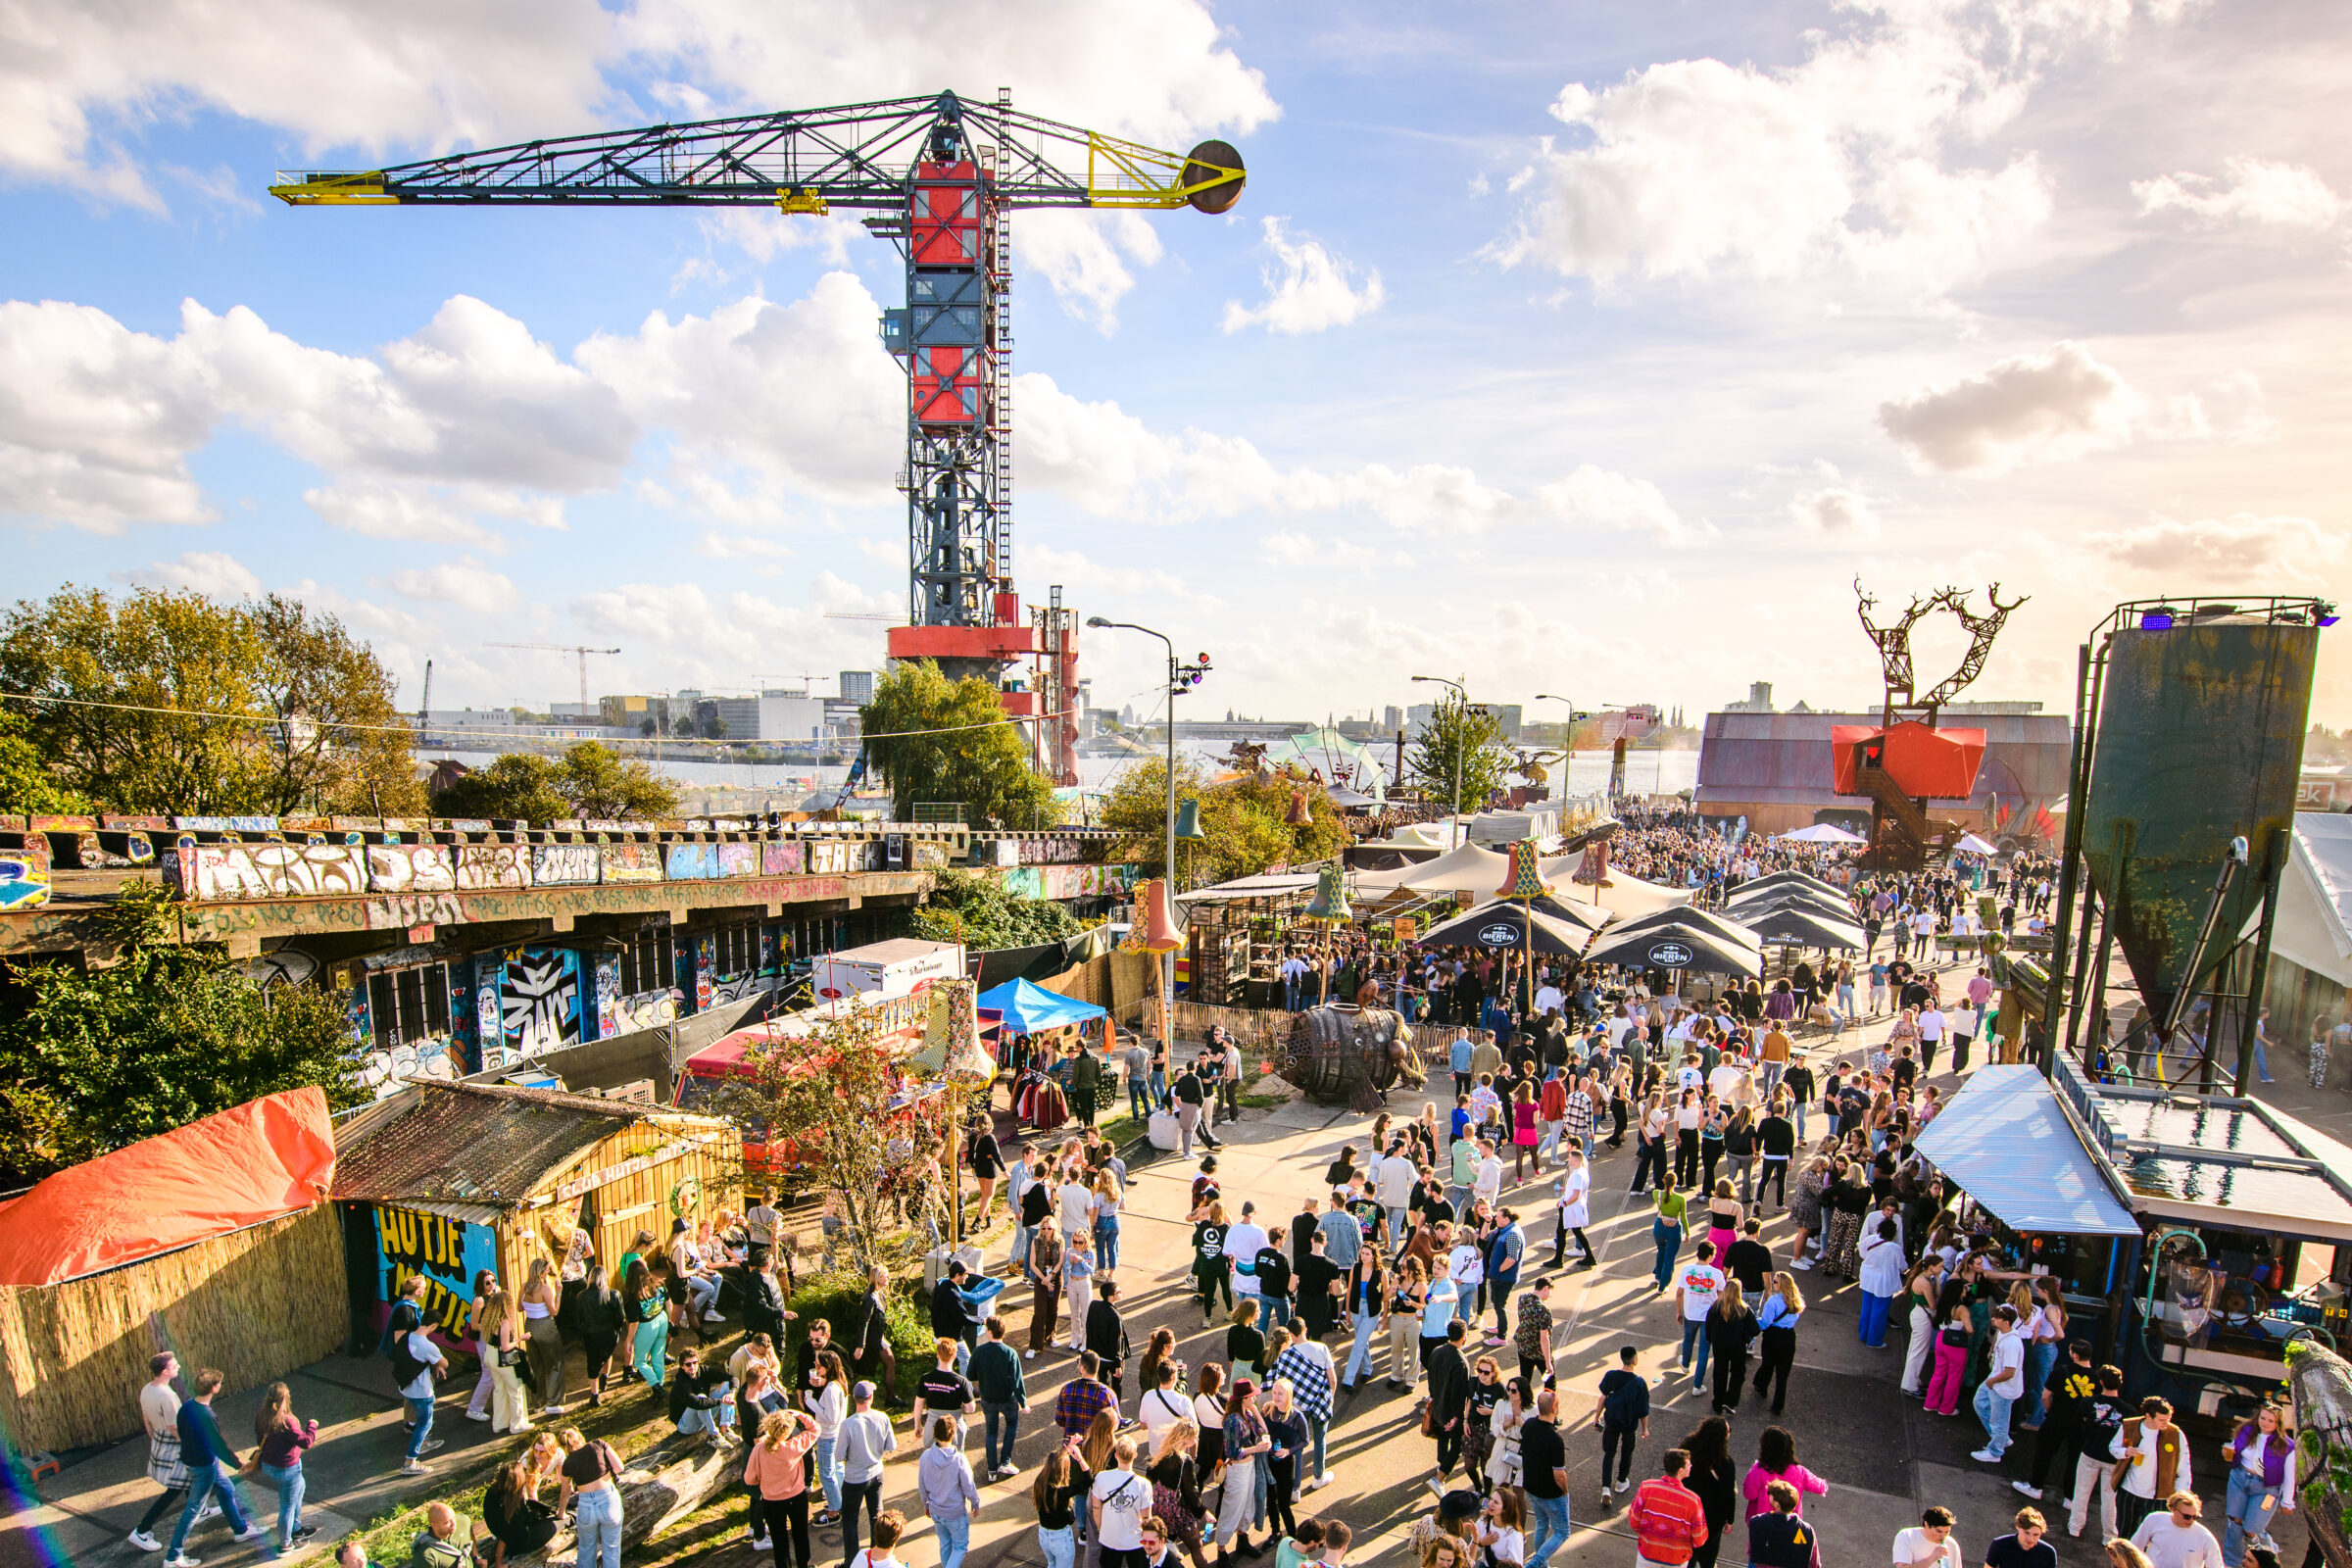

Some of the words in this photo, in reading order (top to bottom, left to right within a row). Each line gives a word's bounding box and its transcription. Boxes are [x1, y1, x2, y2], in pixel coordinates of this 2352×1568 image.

[1653, 953, 1688, 961] BIEREN
[562, 1174, 602, 1199] CLUB
[605, 1154, 651, 1183] HUTJE
[377, 1205, 462, 1268] HUTJE
